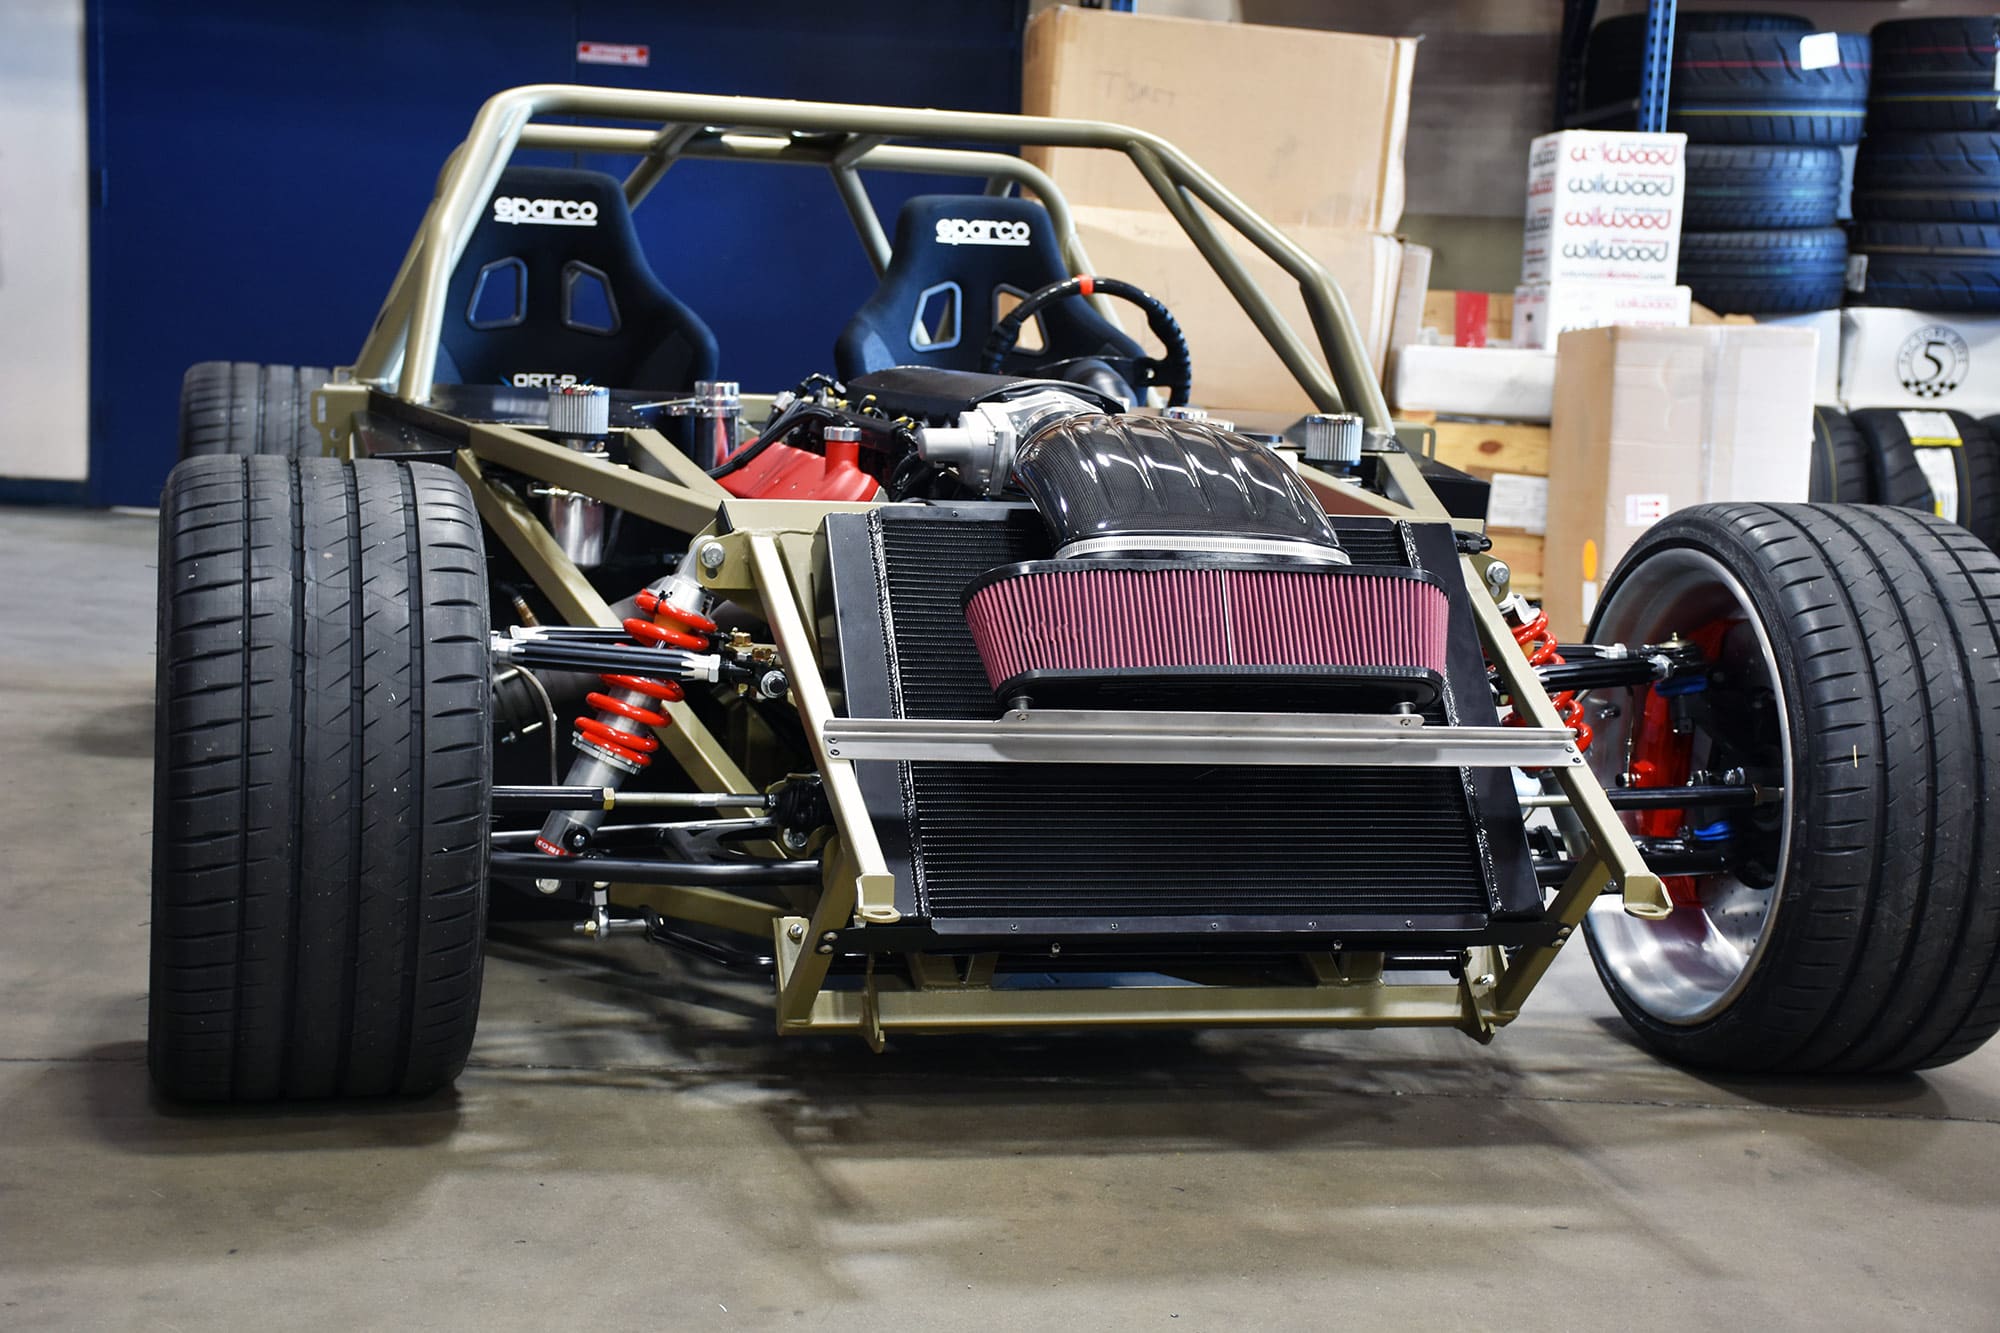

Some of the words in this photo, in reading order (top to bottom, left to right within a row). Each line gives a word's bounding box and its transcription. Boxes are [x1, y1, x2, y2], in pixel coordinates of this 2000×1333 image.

[494, 196, 598, 226] sparco
[936, 218, 1030, 246] sparco
[1921, 341, 1945, 383] 5
